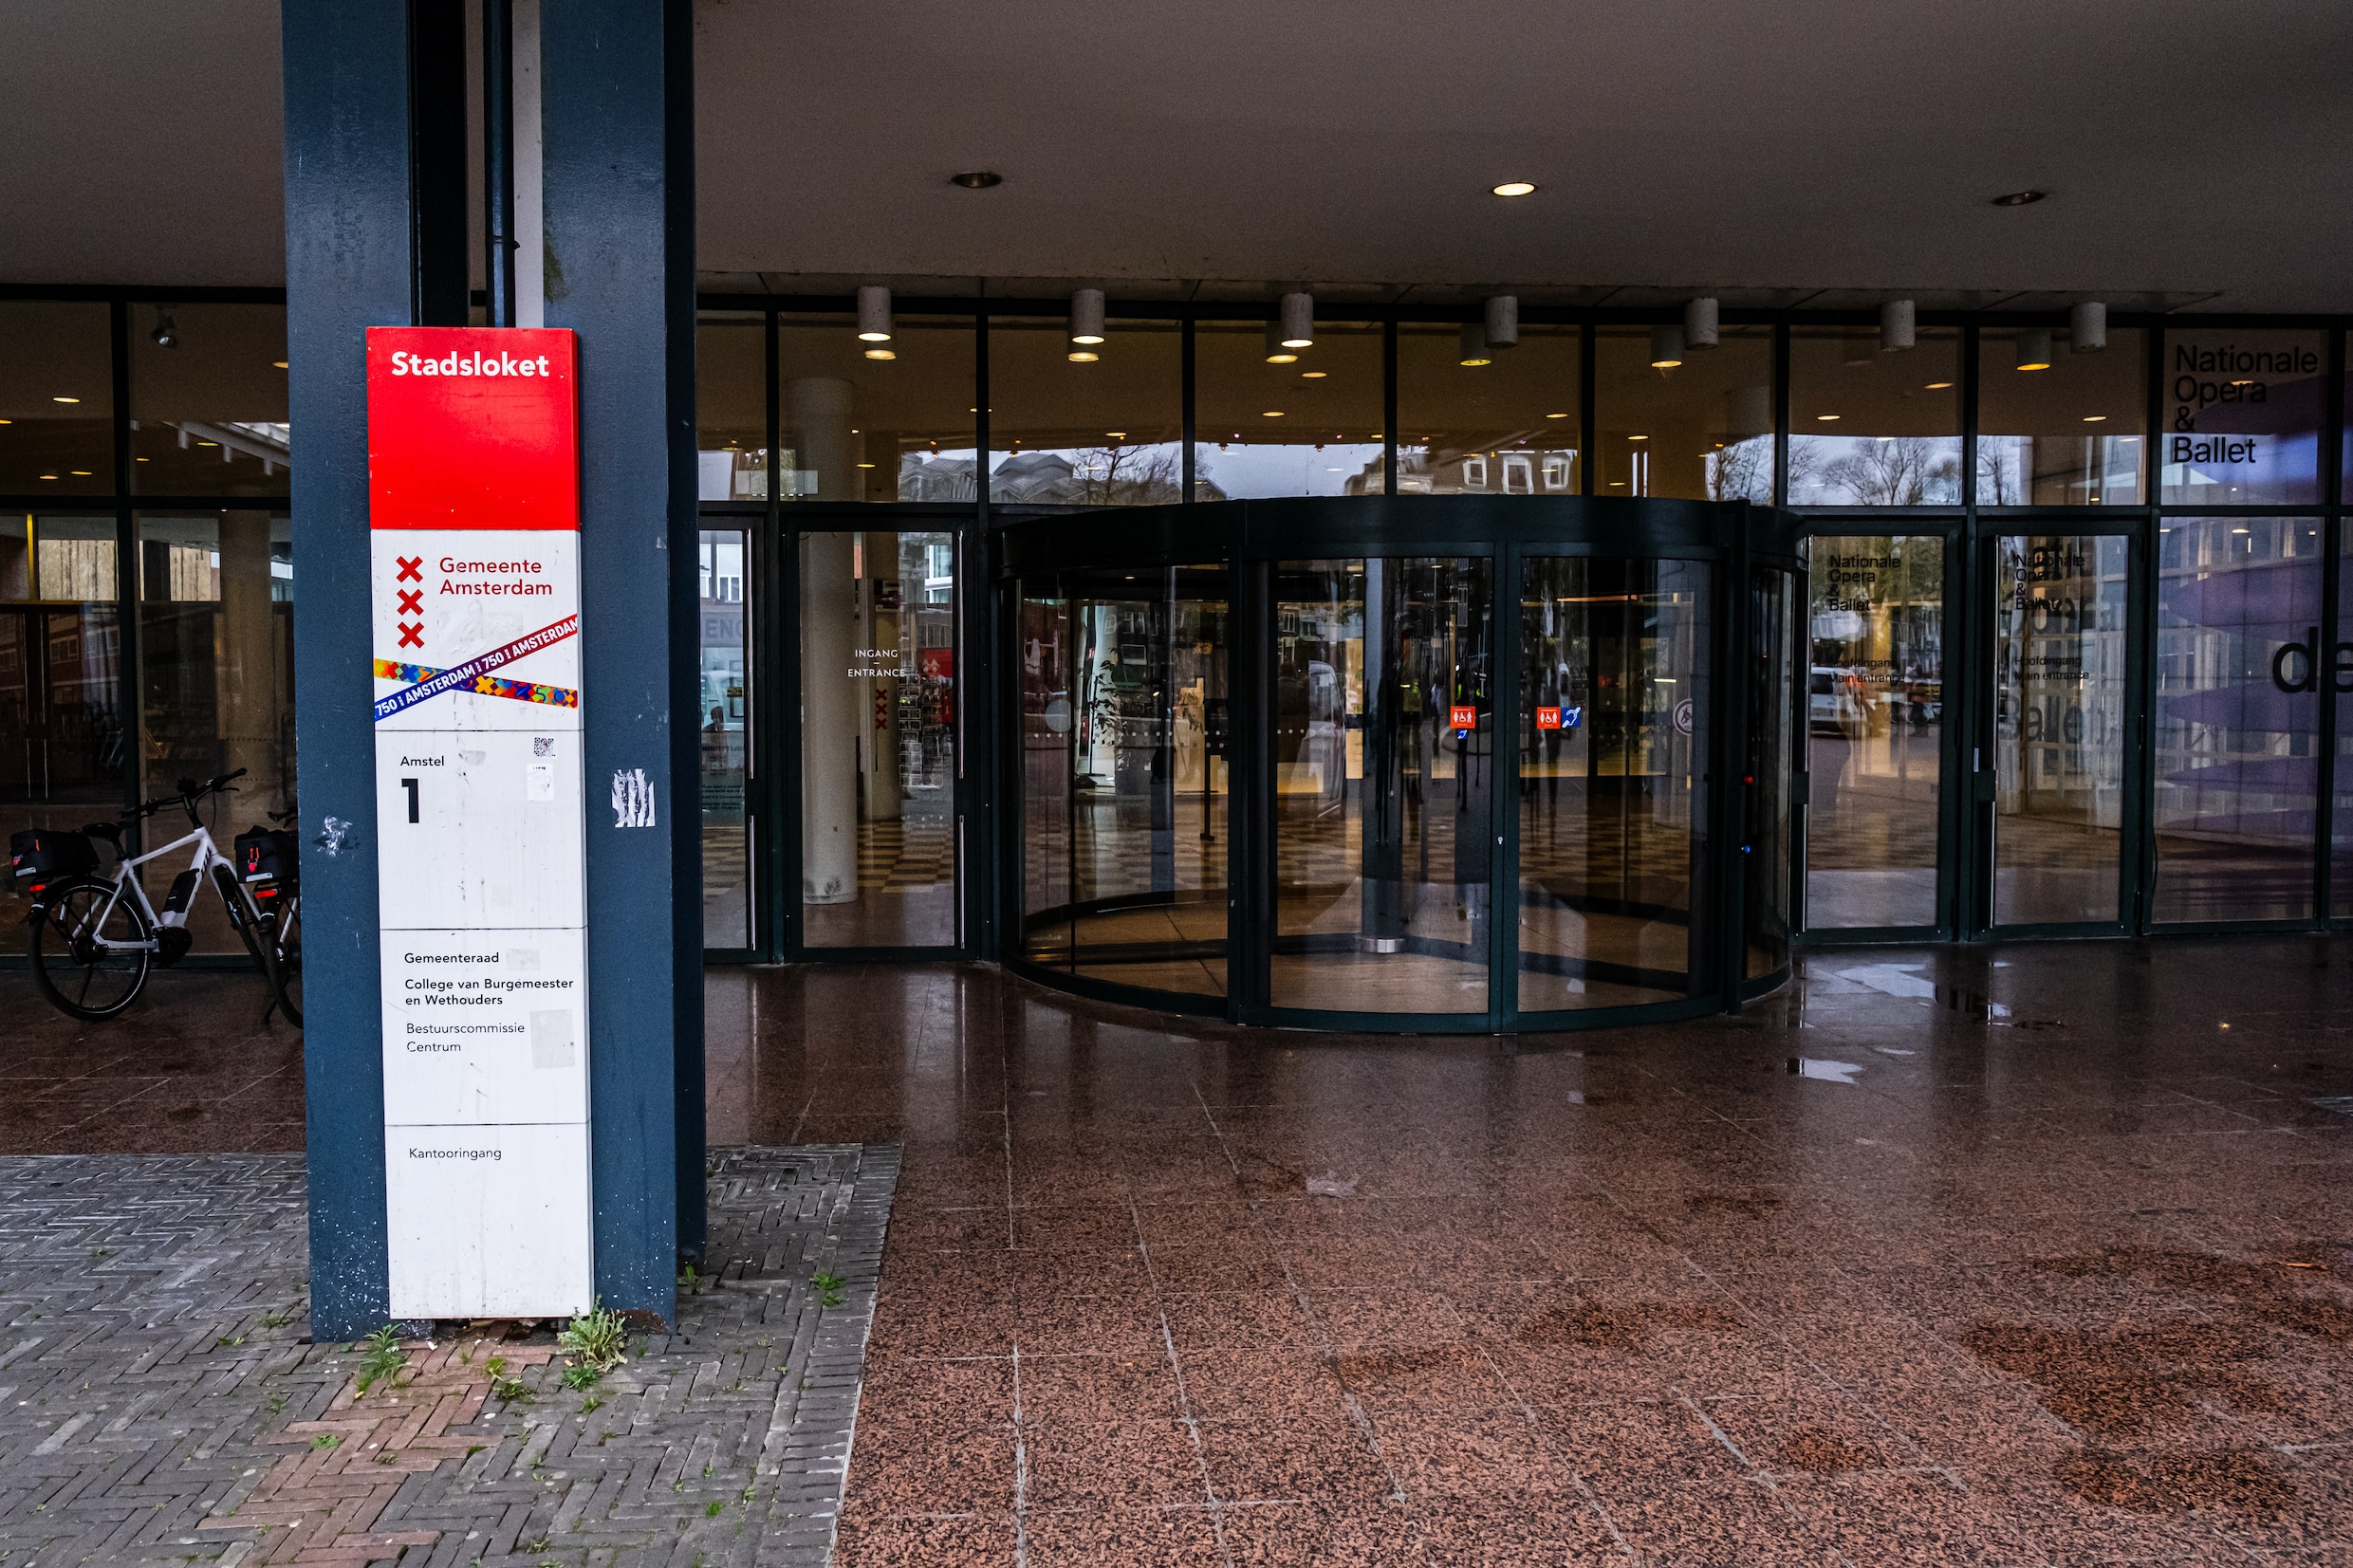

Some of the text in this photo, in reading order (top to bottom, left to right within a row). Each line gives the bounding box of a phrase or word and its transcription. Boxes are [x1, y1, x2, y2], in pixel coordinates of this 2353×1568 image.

[391, 351, 549, 377] Stadsloket
[2177, 344, 2318, 373] Nationale
[2175, 376, 2267, 408] Opera
[2175, 406, 2195, 433] &
[2174, 436, 2256, 463] Ballet
[439, 558, 542, 574] Gemeente
[1829, 554, 1900, 568] Nationale
[2015, 553, 2084, 567] Nationale
[1829, 571, 1876, 584] Opera
[2015, 569, 2061, 582] Opera
[439, 580, 552, 595] Amsterdam
[2015, 583, 2026, 595] &
[1829, 598, 1871, 612] Ballet
[2015, 598, 2056, 611] Ballet
[1830, 657, 1899, 670] oofdingan
[2013, 656, 2082, 668] Hoofdingang
[847, 669, 905, 677] ENTRANCE
[1830, 673, 1904, 683] Main entrance
[2014, 671, 2089, 681] Main entrance
[375, 698, 398, 716] 750
[405, 664, 475, 704] AMSTERDAM
[482, 652, 504, 670] 750
[400, 756, 444, 766] Amstel
[401, 778, 419, 823] 1
[404, 951, 499, 964] Gemeenteraad
[405, 979, 454, 991] College
[485, 978, 574, 991] Burgemeester
[405, 994, 503, 1005] en Wethouders
[406, 1023, 525, 1035] Bestuurscommissie
[406, 1041, 461, 1053] Centrum
[409, 1148, 502, 1161] Kantooringang
